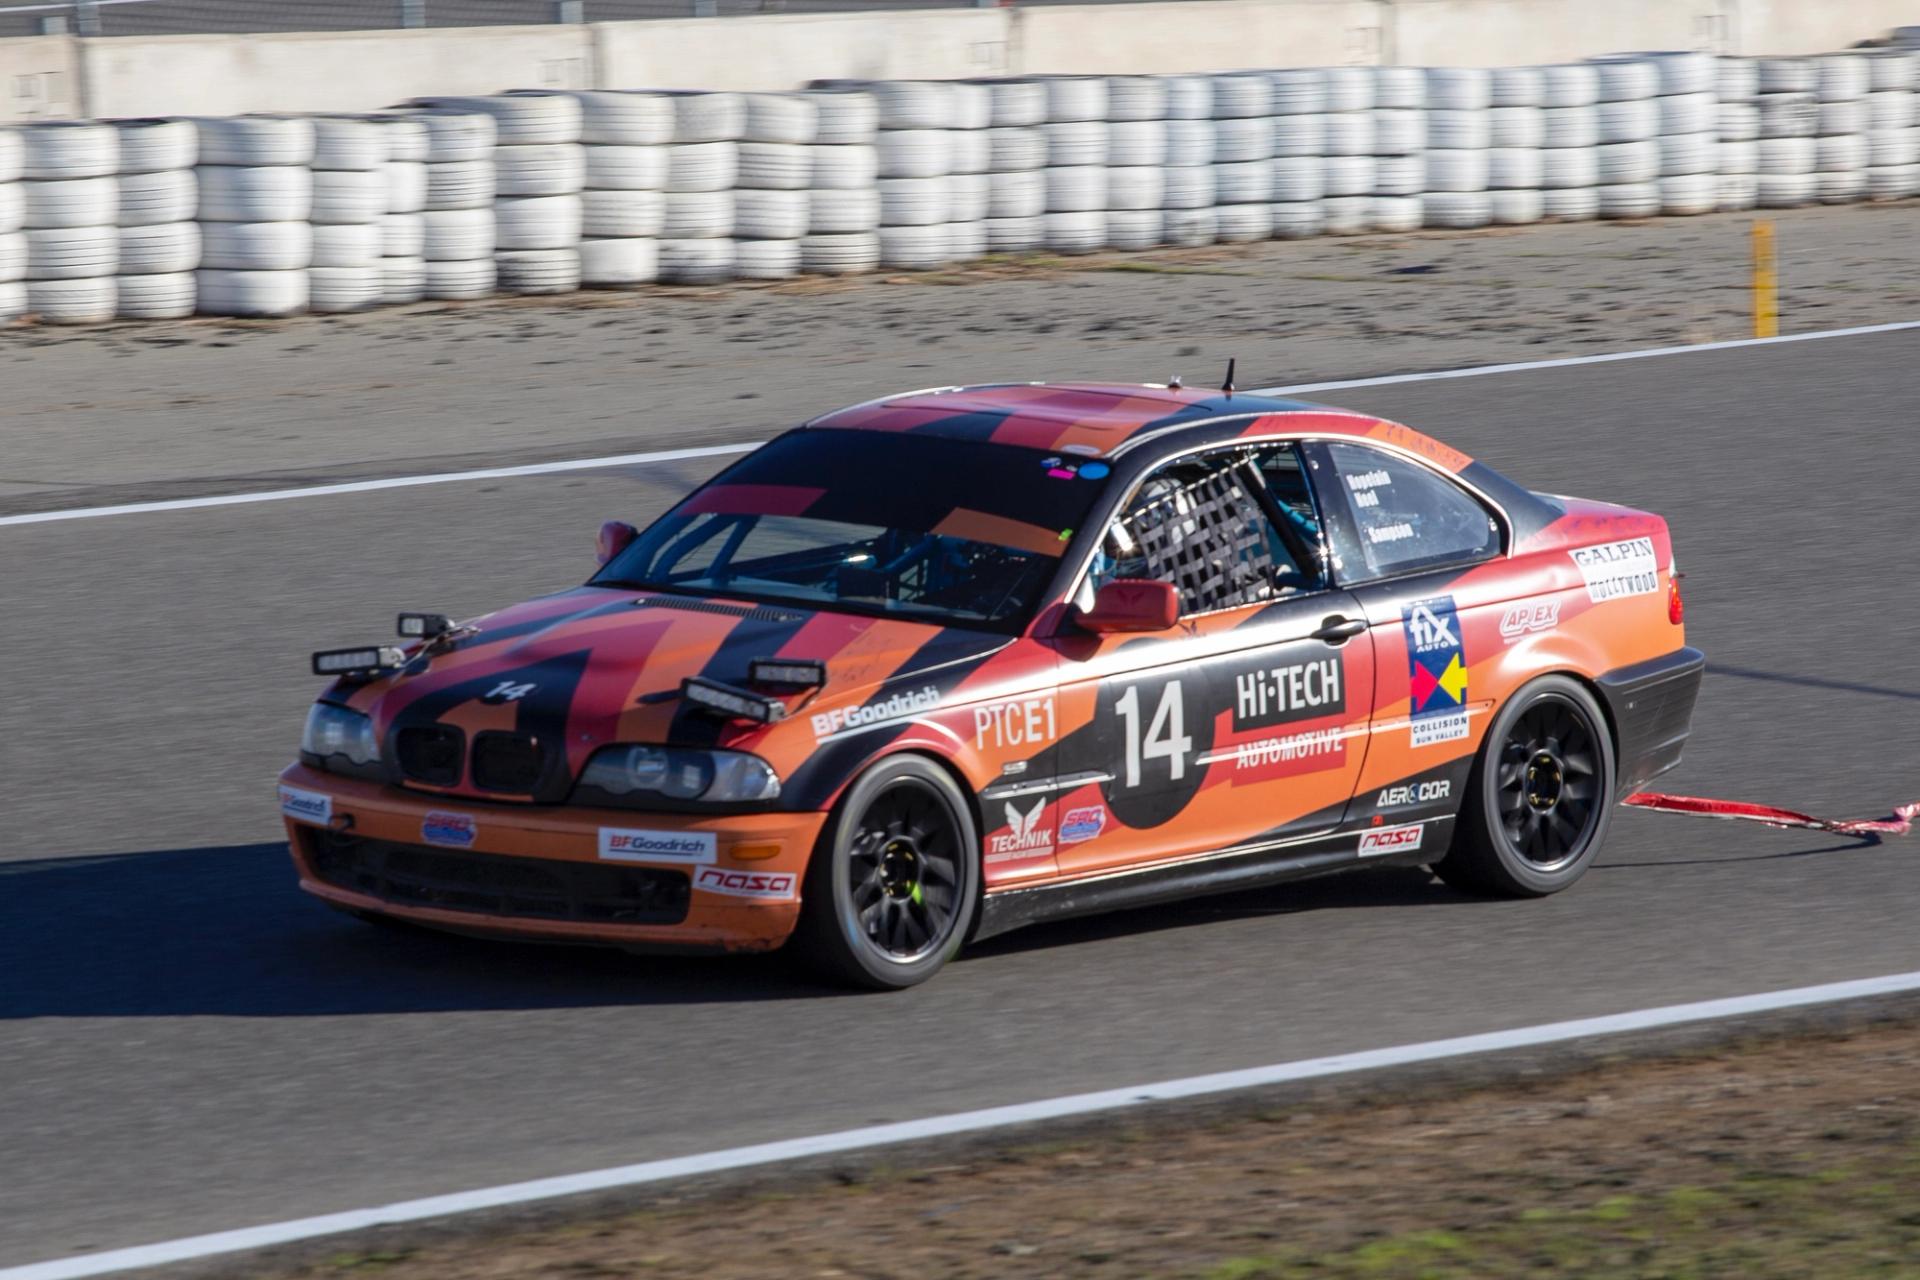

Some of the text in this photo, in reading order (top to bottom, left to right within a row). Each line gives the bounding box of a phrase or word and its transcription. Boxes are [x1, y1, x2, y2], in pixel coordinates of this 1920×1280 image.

[1574, 539, 1653, 567] GALPIN
[1589, 571, 1657, 599] HOLLYWOOD
[1409, 606, 1460, 647] fix
[1504, 604, 1555, 629] APEX
[1416, 641, 1450, 653] AUTO
[485, 680, 537, 700] 14
[810, 685, 940, 737] BFGoodrich
[974, 698, 1056, 751] PTCE1
[1115, 680, 1193, 788] 14
[1413, 716, 1467, 734] COLLISION
[1416, 729, 1463, 744] SUN VALLEY
[1236, 727, 1343, 770] AUTOMOTIVE
[609, 834, 706, 852] BFGoodrich
[991, 829, 1052, 853] TECHNIK
[1362, 828, 1422, 849] nasa
[699, 869, 792, 892] nasa
